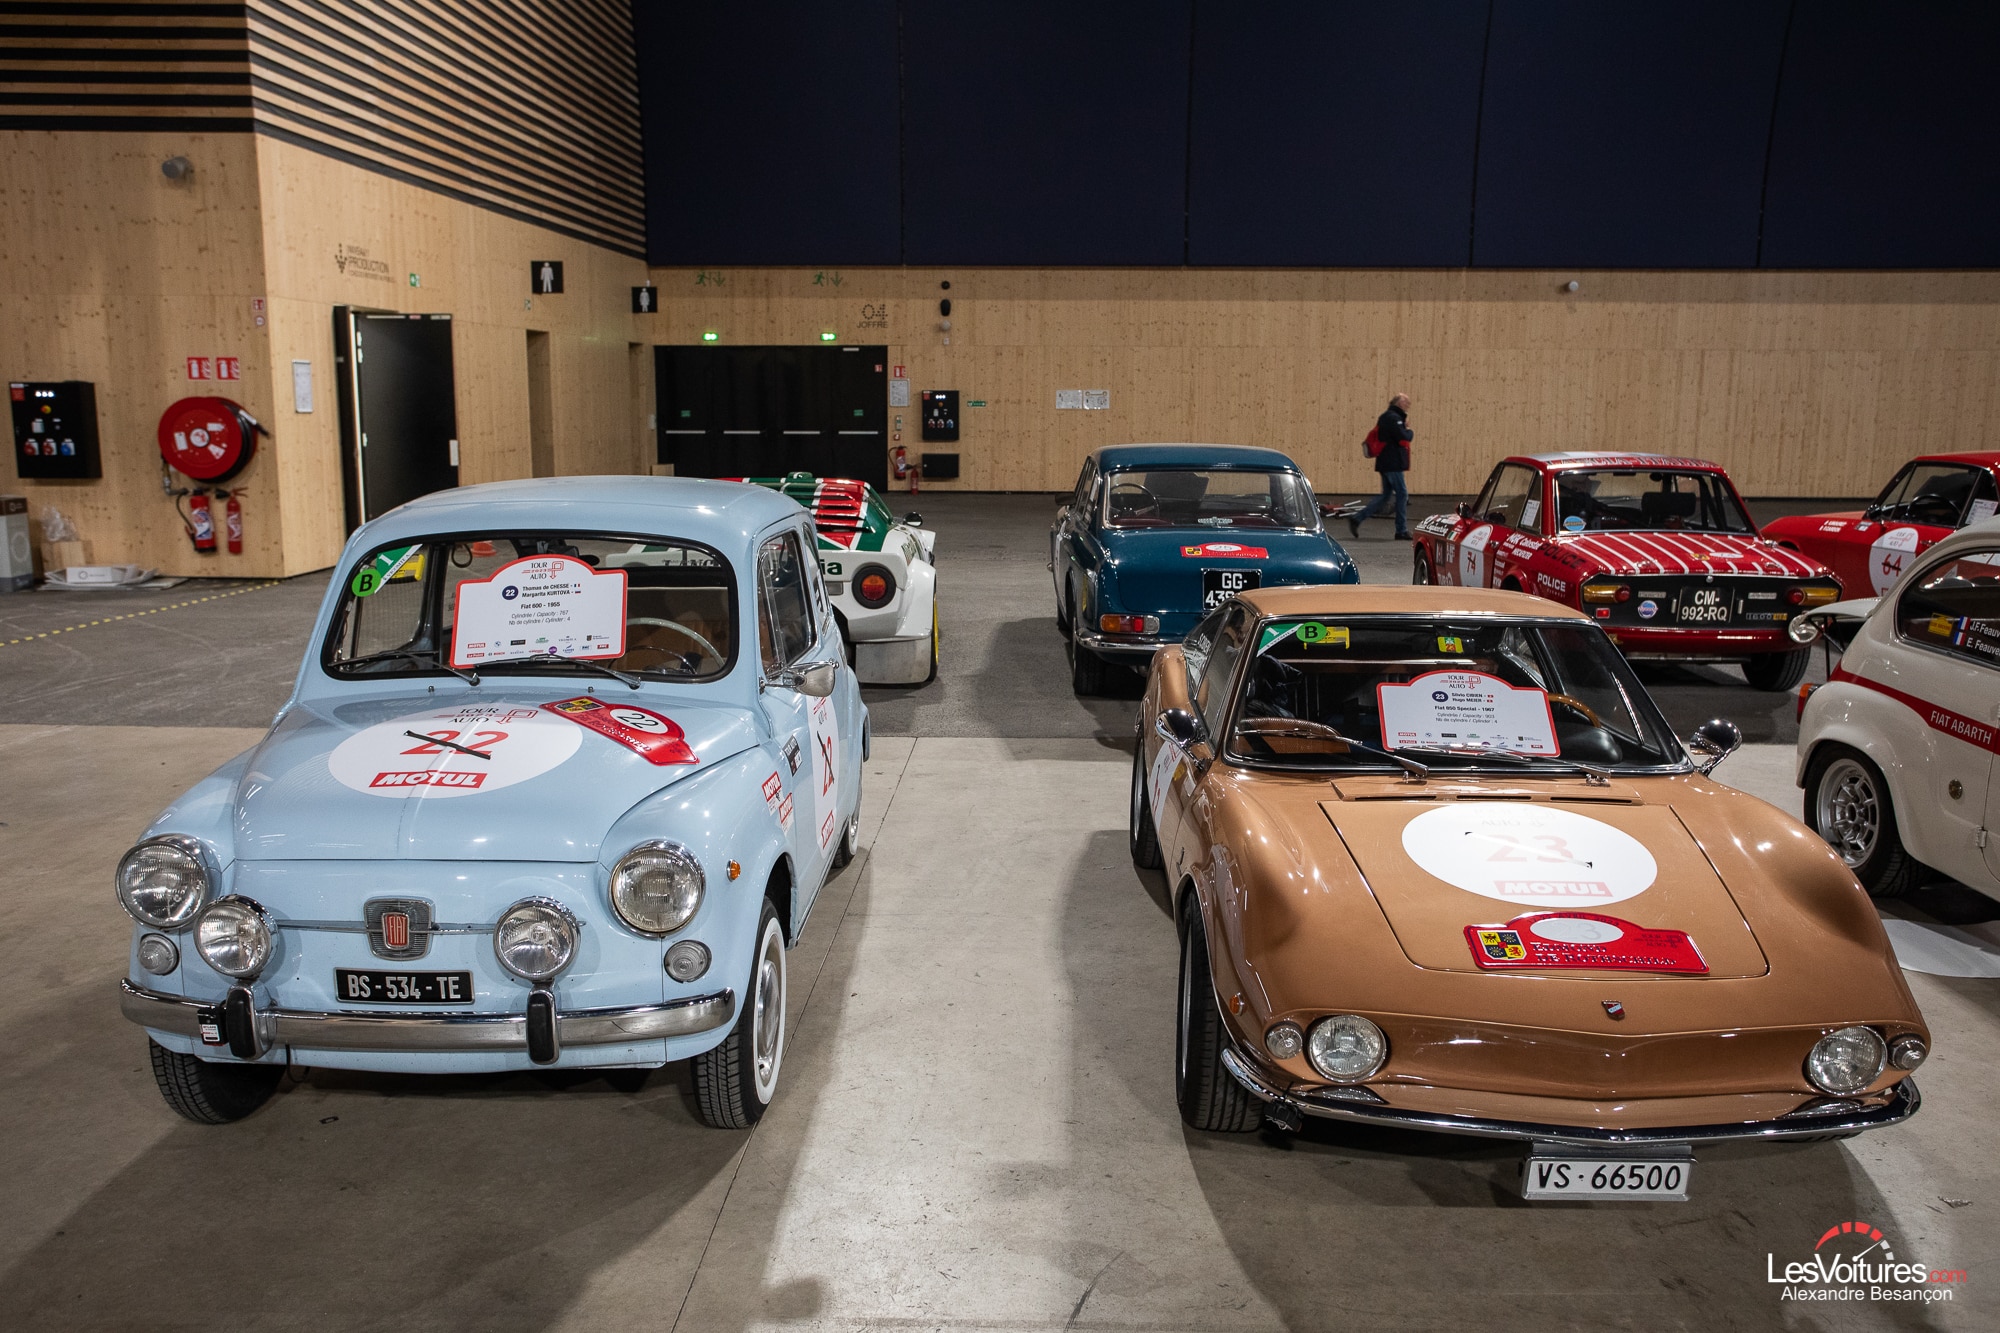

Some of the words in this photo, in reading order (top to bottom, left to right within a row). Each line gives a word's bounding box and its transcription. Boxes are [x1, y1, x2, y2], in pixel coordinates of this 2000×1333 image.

[861, 304, 888, 320] 04
[359, 574, 373, 592] B
[1538, 572, 1566, 593] POLICE
[505, 589, 515, 597] 22
[1681, 606, 1727, 621] 992-RQ
[1304, 625, 1318, 639] B
[447, 716, 490, 724] AUTO
[616, 713, 659, 729] 22
[1930, 710, 1951, 728] FIAT
[1950, 719, 1992, 745] ABARTH
[400, 730, 509, 756] 22
[376, 773, 478, 787] MOTUL
[1486, 834, 1574, 863] 23
[1503, 881, 1606, 895] MOTUL
[389, 915, 406, 944] FIAT
[1530, 941, 1607, 953] EDMOND
[1536, 953, 1561, 963] DE
[1562, 953, 1677, 966] ROTHSCHILD
